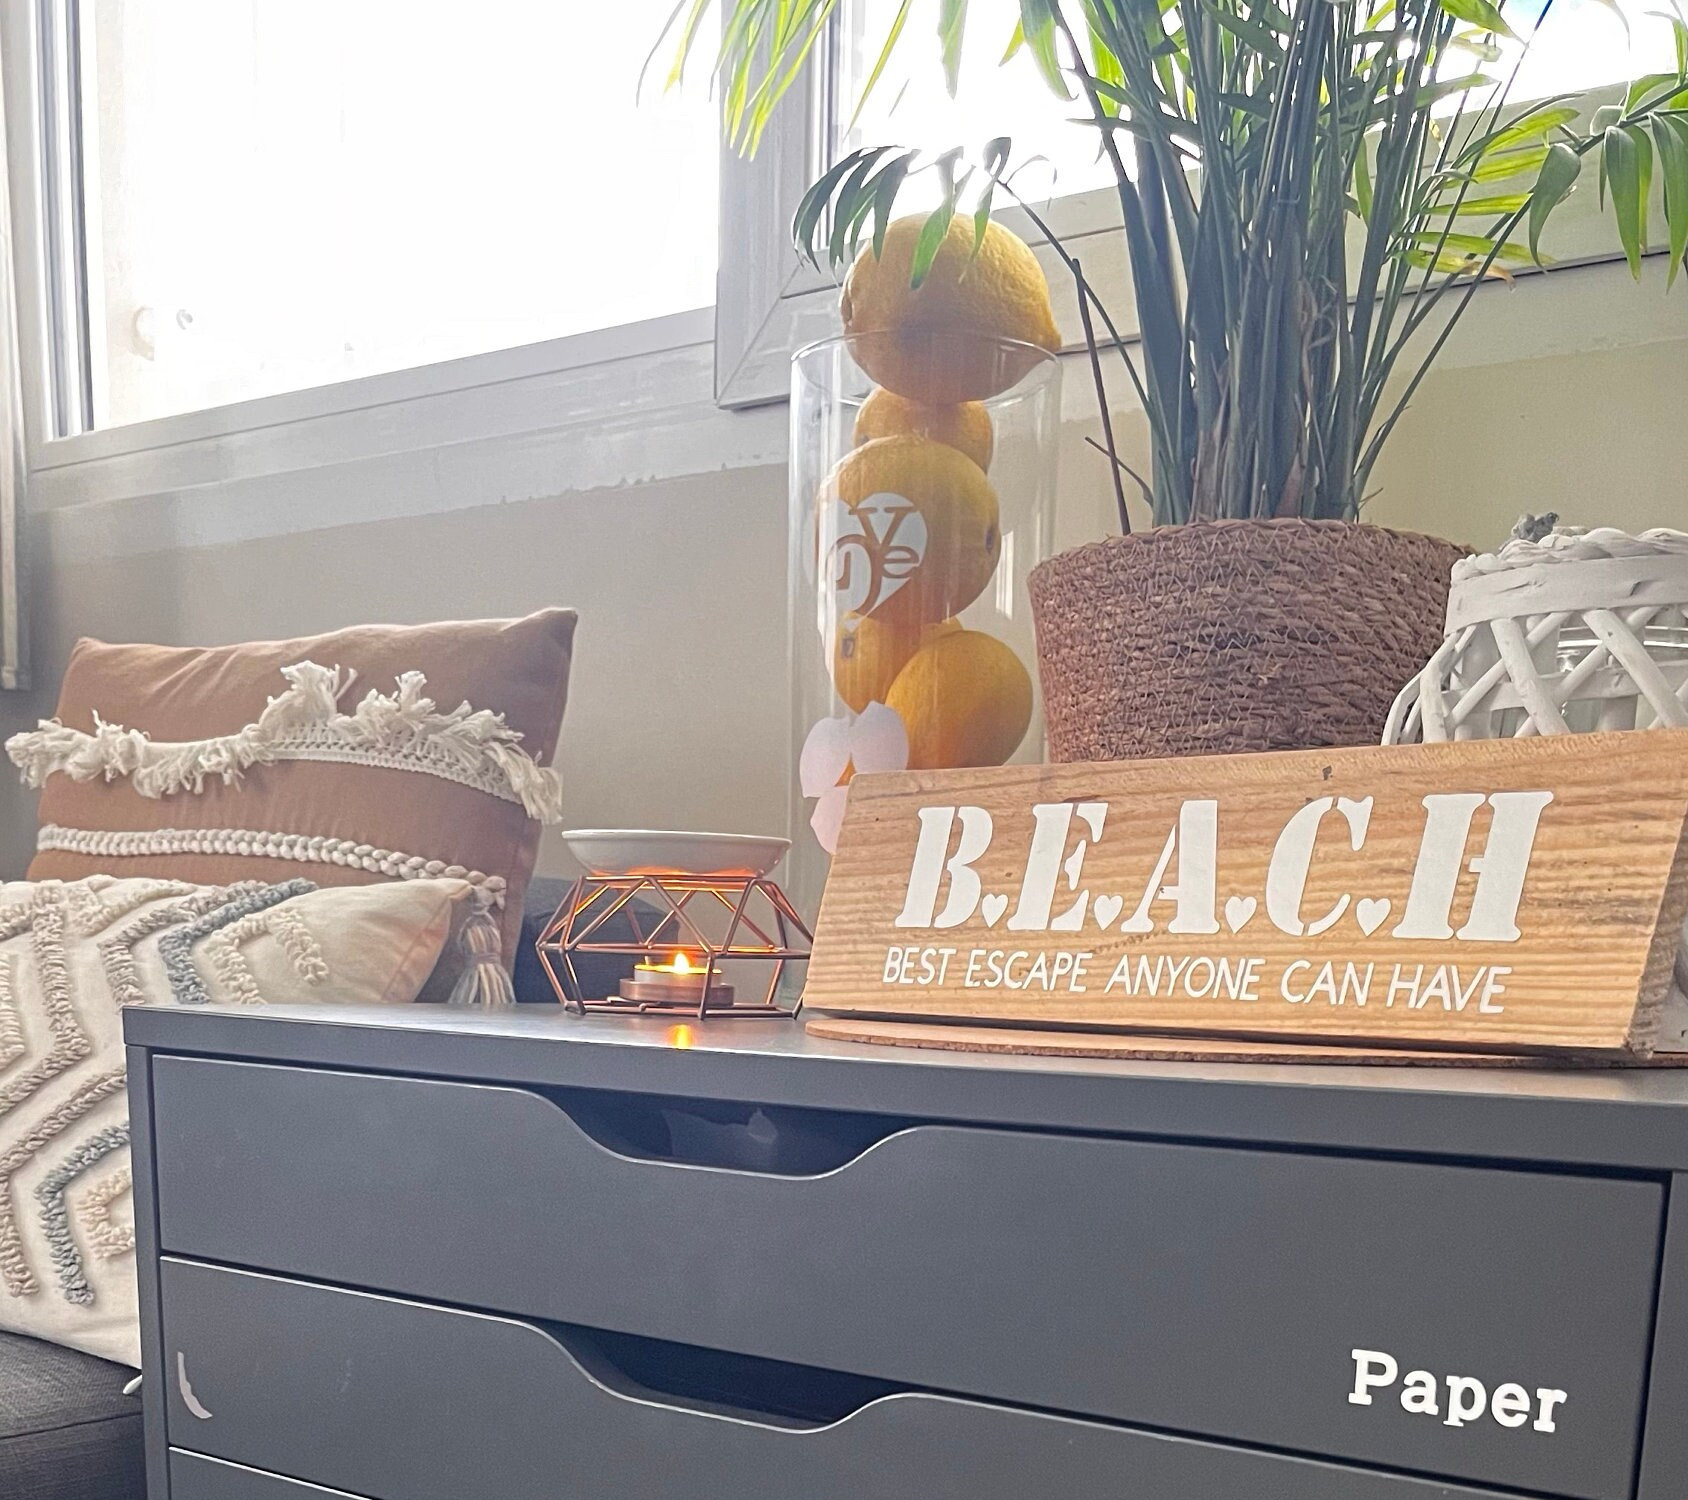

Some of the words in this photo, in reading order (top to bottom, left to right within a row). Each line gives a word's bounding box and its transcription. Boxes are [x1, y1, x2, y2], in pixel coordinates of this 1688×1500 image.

[882, 945, 957, 987] BEST
[964, 948, 1094, 993] ESCAPE
[1103, 954, 1266, 1001] ANYONE
[1280, 959, 1375, 1007] CAN
[1386, 963, 1513, 1014] HAVE
[1347, 1348, 1568, 1434] Paper
